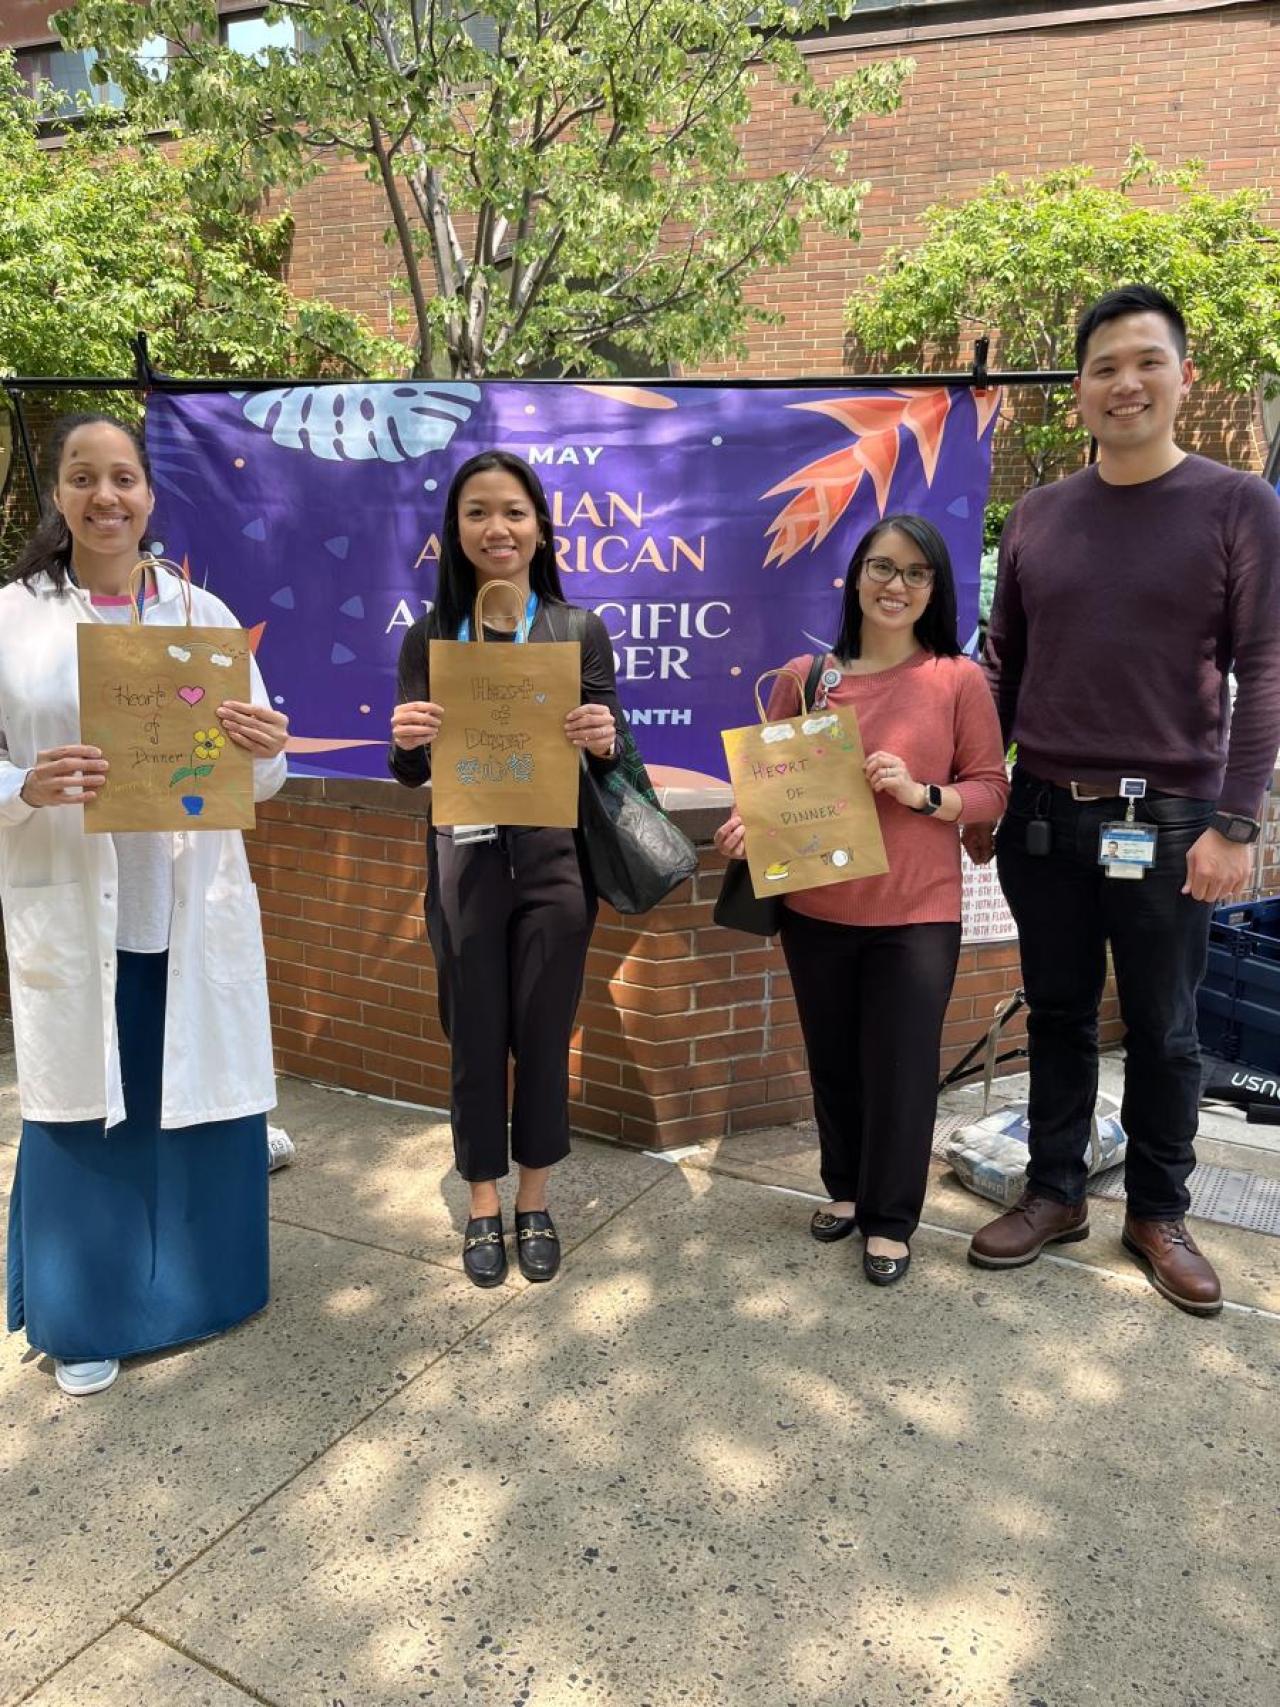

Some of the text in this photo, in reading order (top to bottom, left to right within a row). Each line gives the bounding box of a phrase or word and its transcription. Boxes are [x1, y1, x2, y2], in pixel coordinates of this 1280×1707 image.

[528, 446, 603, 465] MAY
[545, 491, 643, 528] IAN
[413, 534, 705, 573] ARICAN
[593, 601, 731, 639] CIFIC
[145, 713, 160, 745] of
[622, 709, 692, 725] NTH
[786, 787, 805, 800] OF
[780, 805, 839, 825] DINNER
